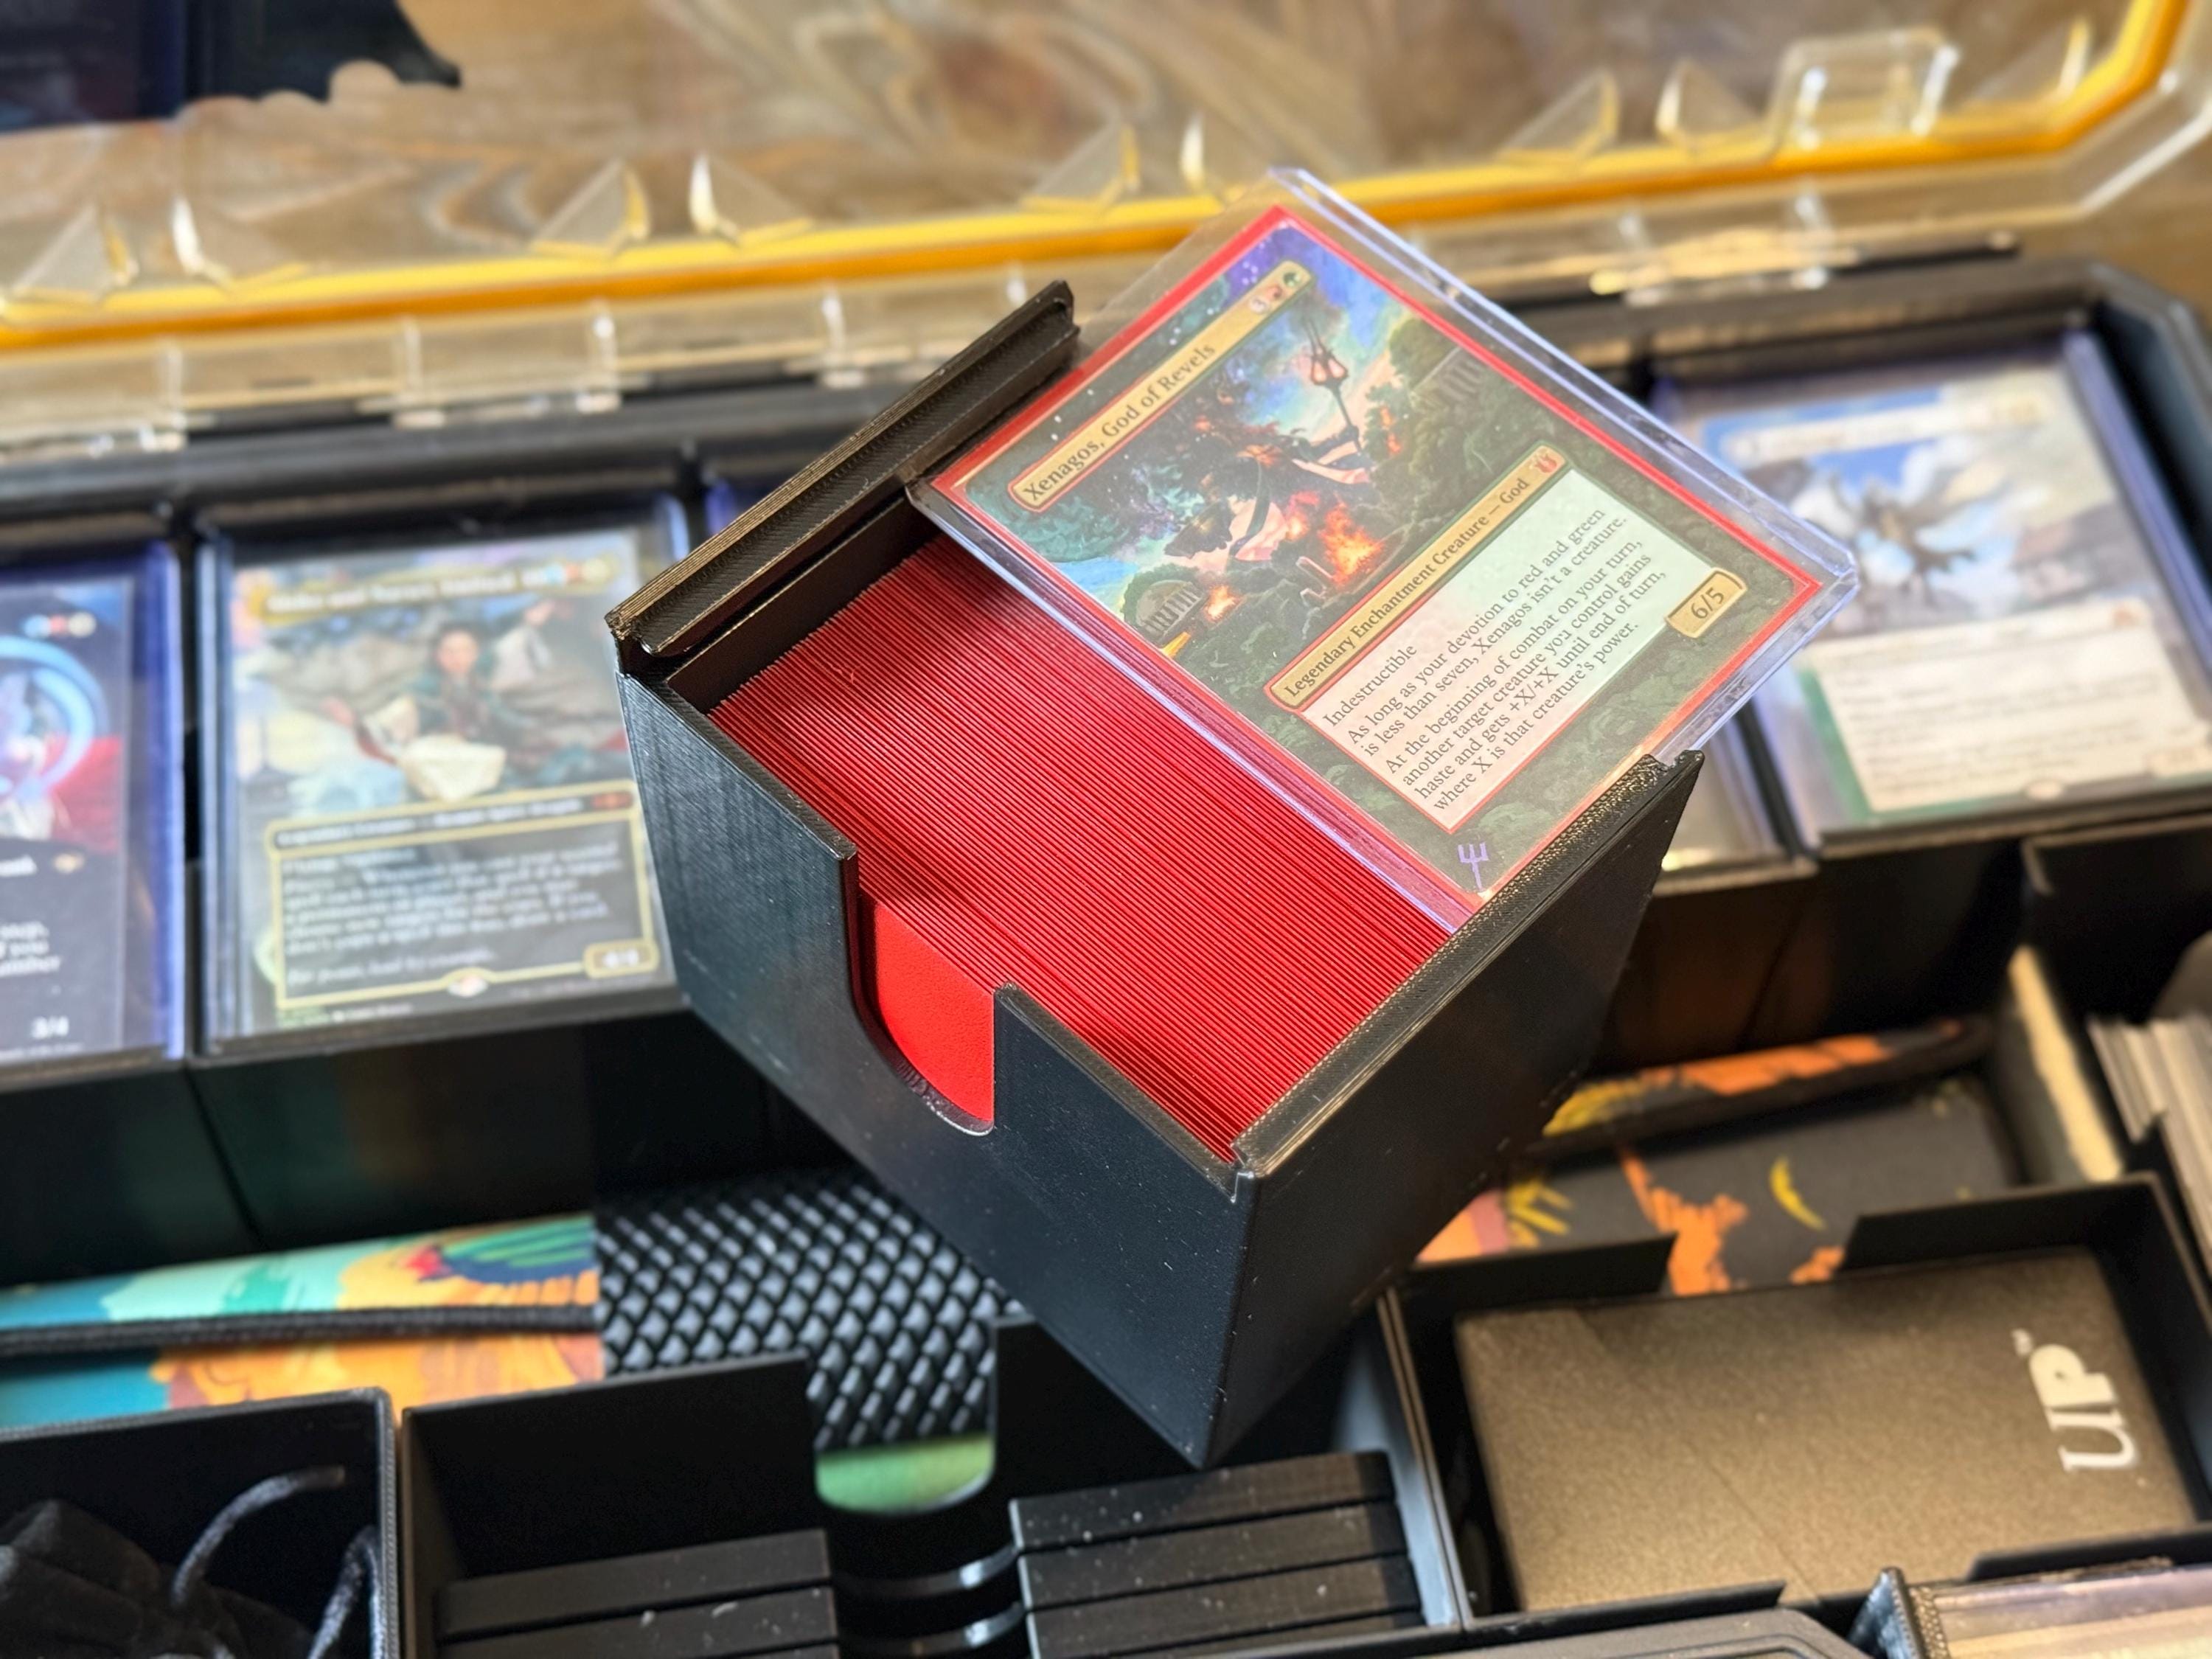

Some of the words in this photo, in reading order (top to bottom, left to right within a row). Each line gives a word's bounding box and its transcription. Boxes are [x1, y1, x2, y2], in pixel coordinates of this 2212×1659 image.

[1022, 440, 1106, 502] Xenagos,
[1101, 403, 1141, 437] God
[1140, 383, 1161, 408] of
[1155, 344, 1216, 392] Revels
[1283, 636, 1357, 698] Legendary
[1349, 563, 1437, 639] Enchantment
[1431, 516, 1489, 566] Creature
[1498, 477, 1531, 504] God
[1322, 646, 1417, 727] Indestructible
[1347, 725, 1370, 745] As
[1364, 696, 1404, 726] long
[1399, 682, 1417, 698] as
[1414, 653, 1448, 686] your
[1446, 603, 1506, 654] devotion
[1501, 588, 1520, 603] to
[1517, 564, 1544, 589] red
[1541, 540, 1571, 568] and
[1568, 509, 1607, 546] green
[1360, 742, 1380, 757] is
[1374, 719, 1406, 745] less
[1402, 692, 1438, 720] than
[1434, 657, 1480, 692] seven,
[1470, 602, 1533, 655] Xenagos
[1530, 574, 1563, 604] isn't
[1559, 566, 1573, 577] a
[1571, 518, 1627, 566] creature.
[1385, 754, 1408, 774] At
[1404, 734, 1430, 756] the
[1424, 674, 1498, 734] beginning
[1493, 655, 1512, 675] of
[1509, 614, 1560, 660] combat
[1557, 597, 1579, 615] on
[1575, 568, 1609, 600] your
[1604, 541, 1643, 569] turn,
[1402, 737, 1455, 786] another
[1452, 701, 1495, 739] target
[1492, 653, 1547, 703] creature
[1543, 629, 1573, 657] you
[1571, 583, 1620, 630] control
[1616, 554, 1652, 589] gains
[1413, 765, 1456, 799] haste
[1454, 737, 1484, 766] and
[1481, 714, 1511, 743] gets
[1509, 666, 1559, 712] +X/+X
[1555, 636, 1591, 669] until
[1588, 611, 1617, 639] end
[1614, 594, 1632, 614] of
[1628, 572, 1666, 600] turn,
[1690, 586, 1726, 621] 6/5
[1433, 773, 1477, 810] where
[1470, 755, 1493, 774] X
[1486, 745, 1506, 760] is
[1503, 719, 1535, 747] that
[1532, 661, 1596, 720] creature's
[1592, 622, 1639, 665] power.
[2029, 1343, 2135, 1472] UP
